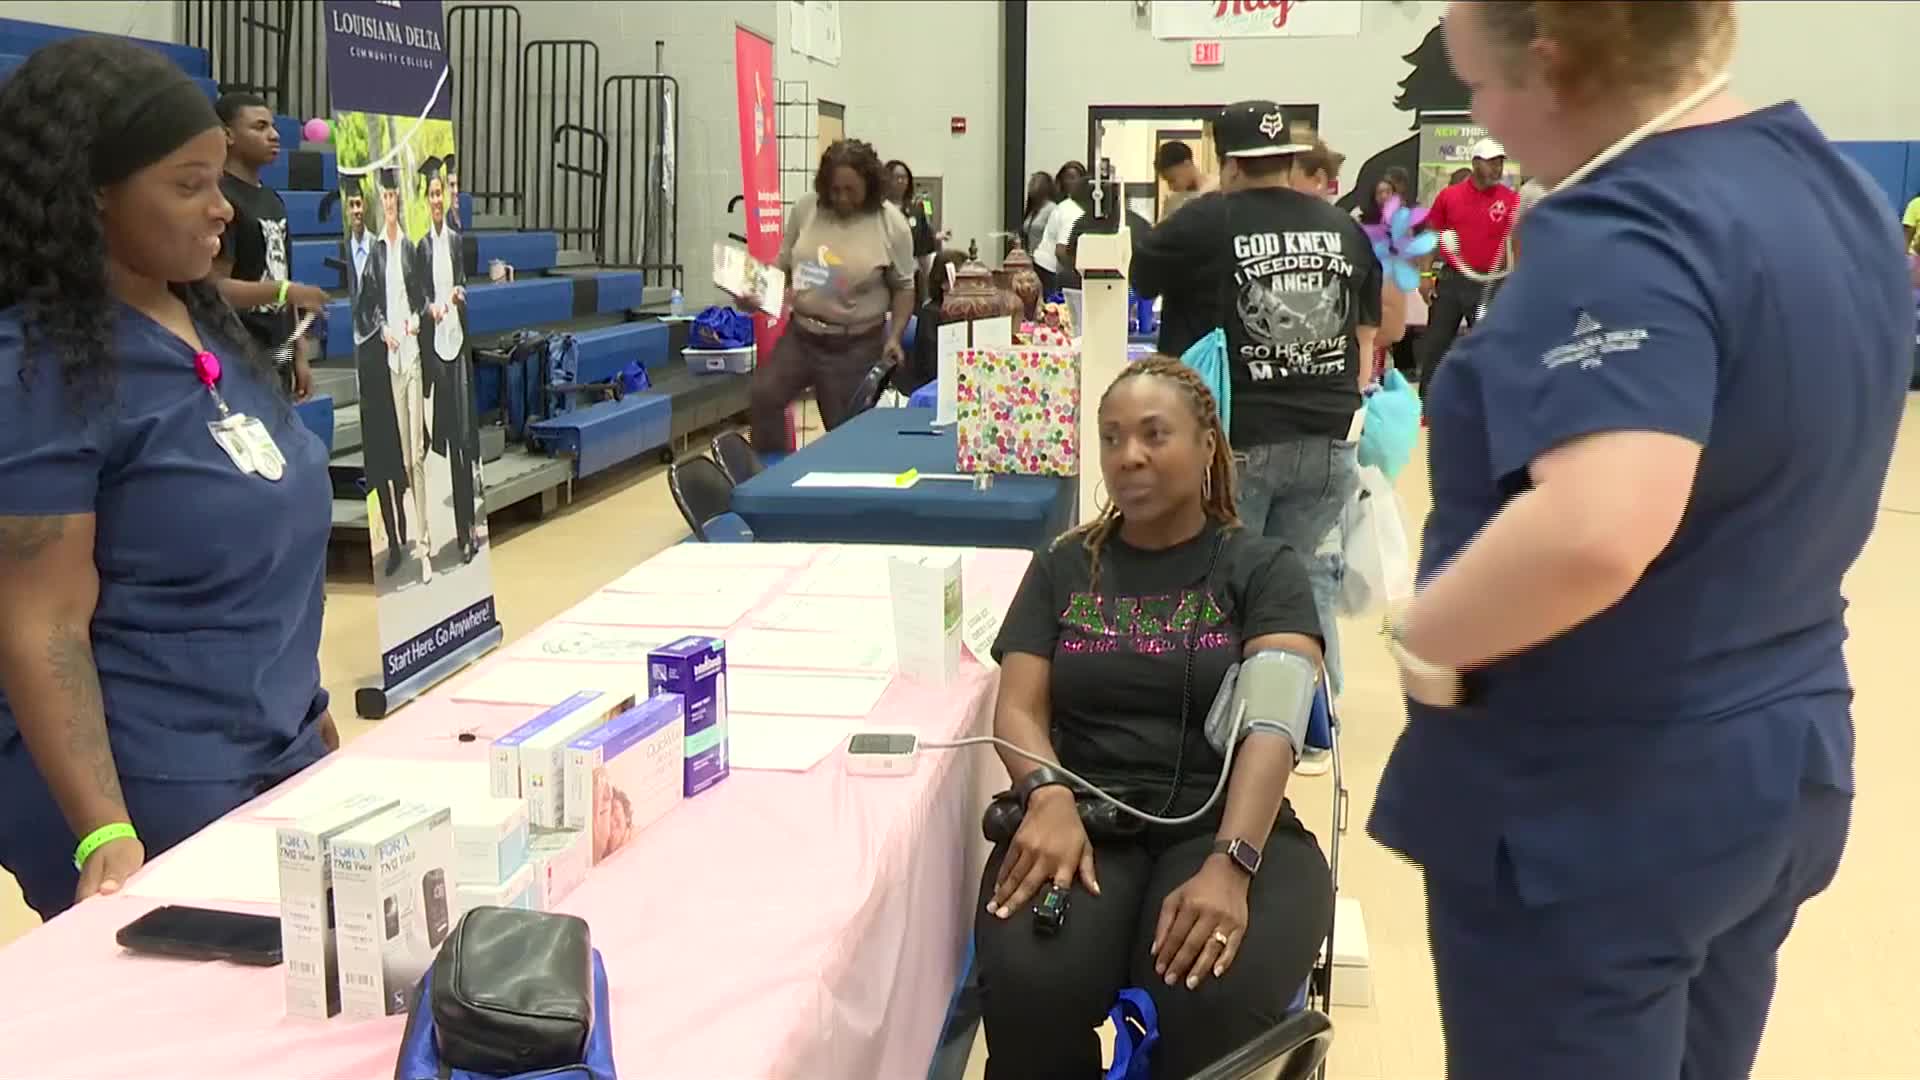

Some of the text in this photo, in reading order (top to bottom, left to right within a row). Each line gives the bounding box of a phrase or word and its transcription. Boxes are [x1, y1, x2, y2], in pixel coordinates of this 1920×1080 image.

[333, 9, 441, 51] LOUISIANA DELTA
[350, 47, 433, 70] COMMUNITY COLLEGE
[1195, 43, 1220, 62] EXIT
[1233, 231, 1342, 259] GOD KNEW
[1234, 255, 1353, 286] I NEEDED AN
[1271, 271, 1323, 292] ANGEL
[1240, 335, 1347, 360] SO HE GAVE
[388, 602, 491, 675] Start Here. Go Anywhere!
